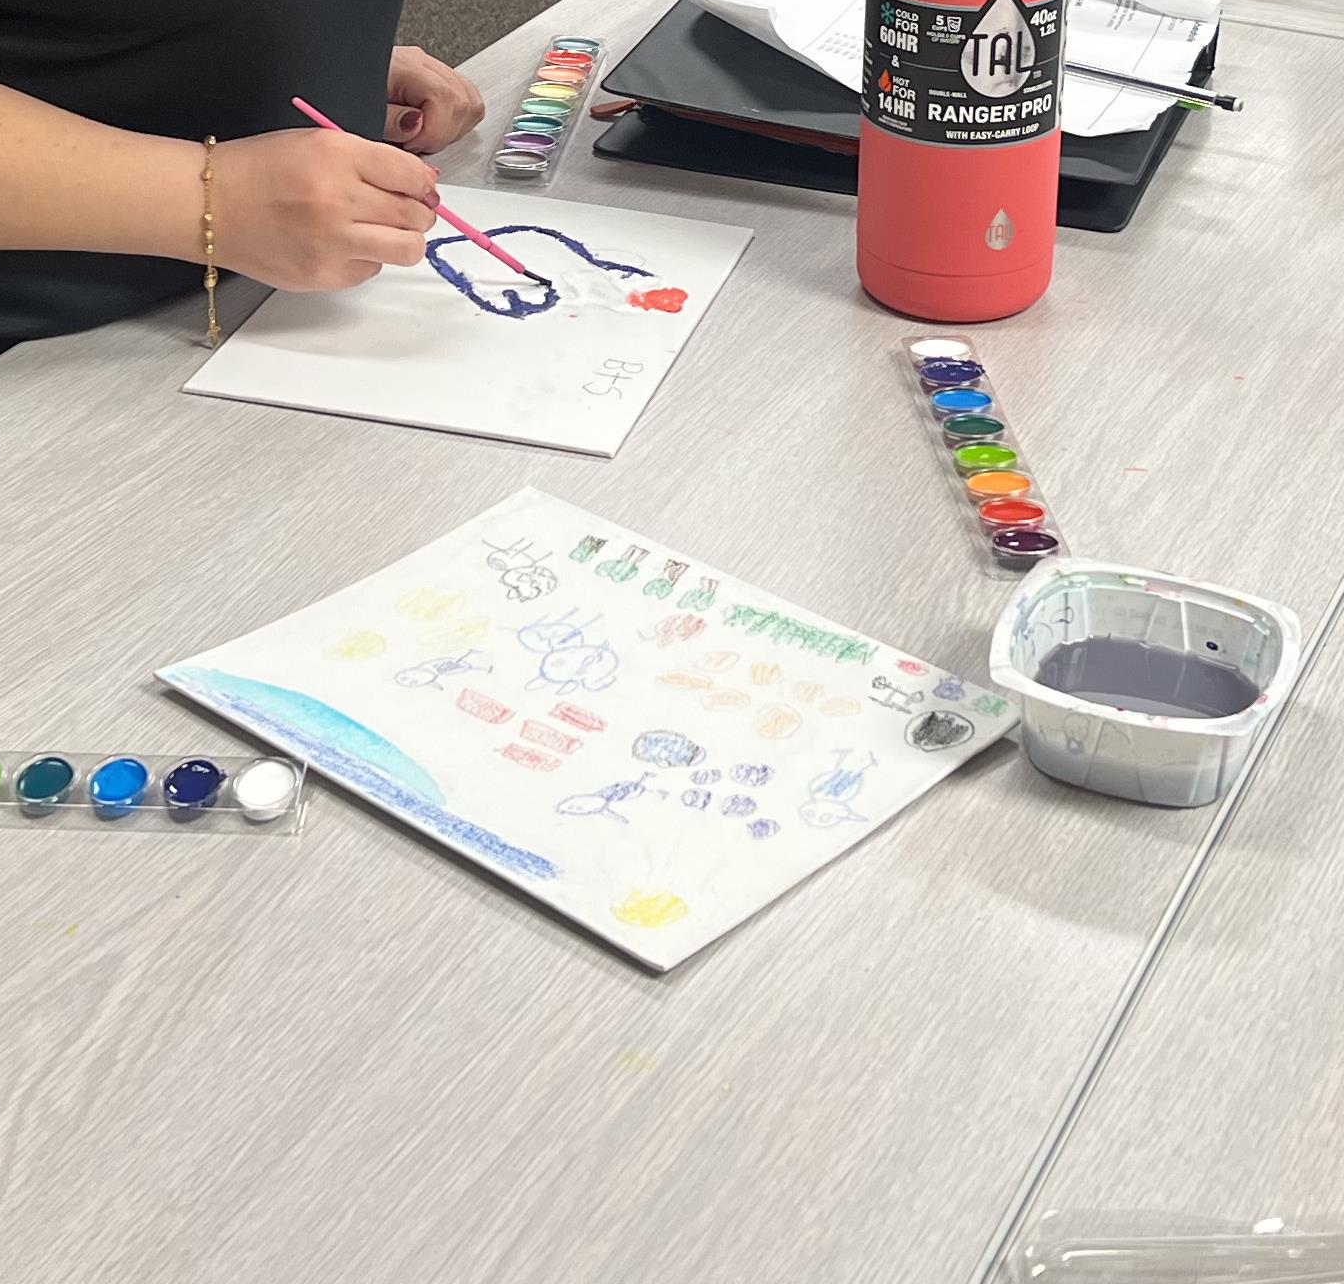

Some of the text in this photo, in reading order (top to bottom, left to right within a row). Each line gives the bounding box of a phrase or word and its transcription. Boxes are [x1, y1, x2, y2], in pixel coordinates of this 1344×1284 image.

[895, 7, 919, 23] COLD
[935, 14, 945, 26] 5
[895, 19, 919, 35] FOR
[1039, 22, 1056, 38] 1.2L
[879, 24, 919, 54] 60HR
[890, 54, 901, 68] &
[968, 30, 1034, 77] TAL
[892, 74, 911, 88] HOT
[892, 85, 917, 102] FOR
[877, 91, 917, 120] 14HR
[927, 102, 1017, 125] RANGER
[1020, 93, 1053, 119] PRO
[945, 122, 1040, 141] WITH EASY-CARRY LOOP
